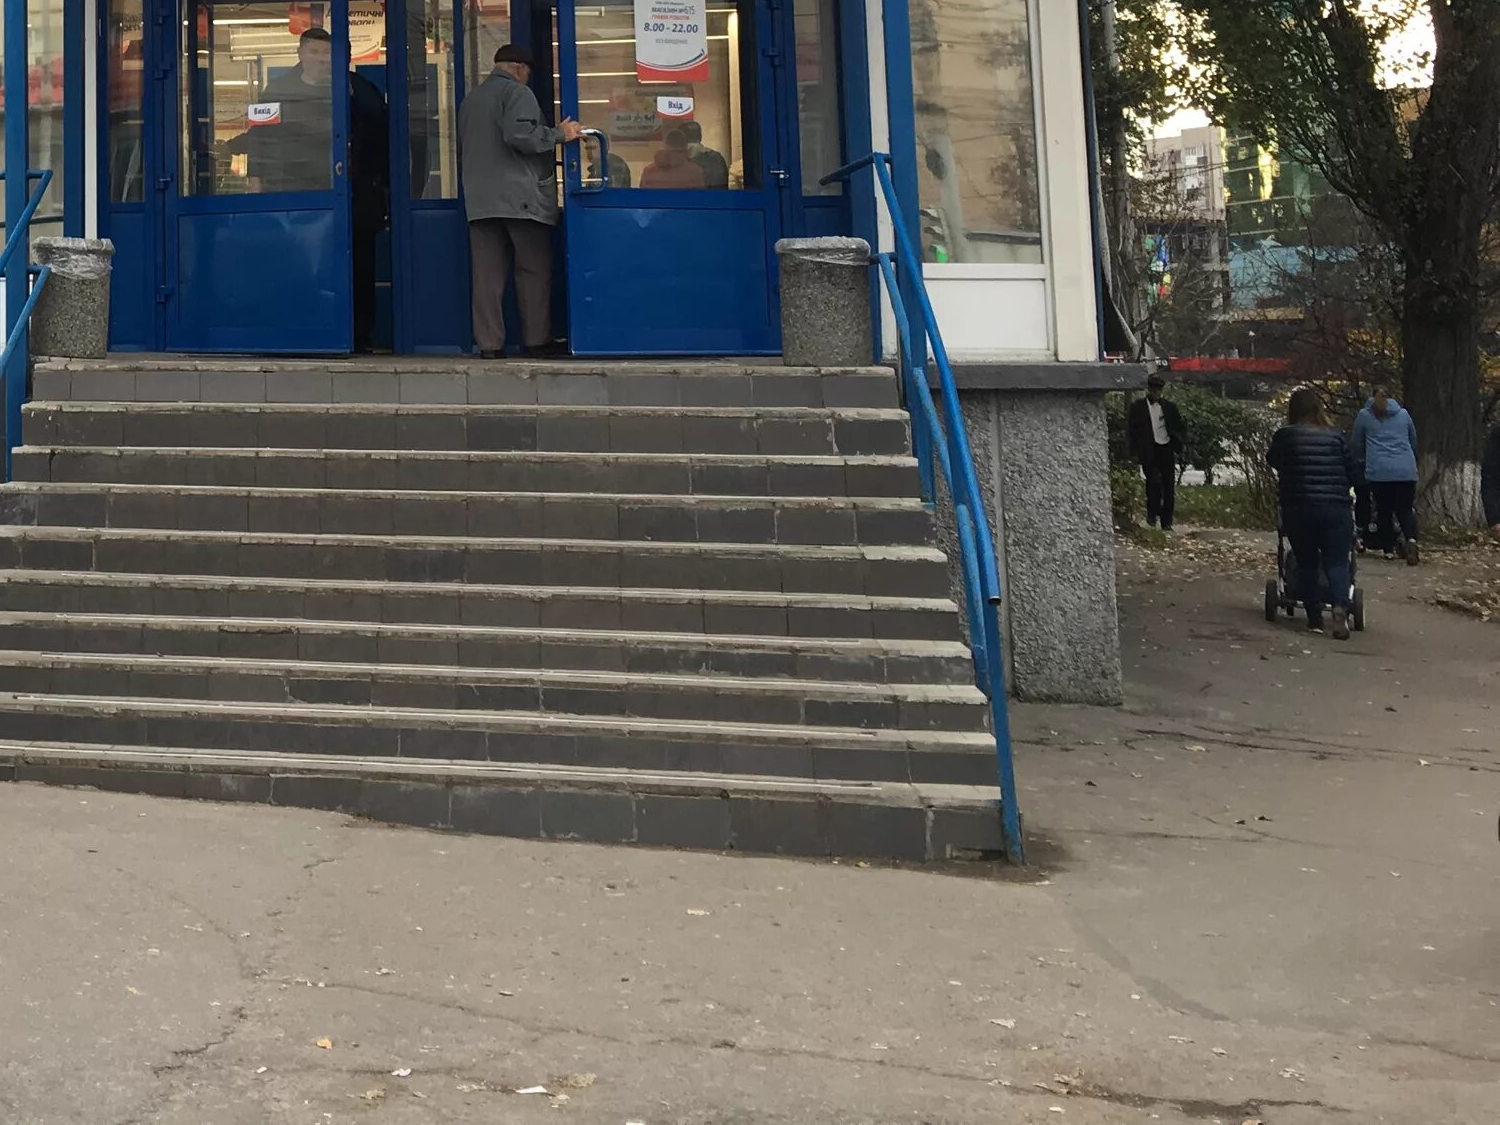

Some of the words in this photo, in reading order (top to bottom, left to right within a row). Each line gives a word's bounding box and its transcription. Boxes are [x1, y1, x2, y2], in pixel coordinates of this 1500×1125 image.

[643, 22, 665, 32] 8.00
[672, 23, 698, 33] 22.00
[668, 100, 684, 111] Вхід
